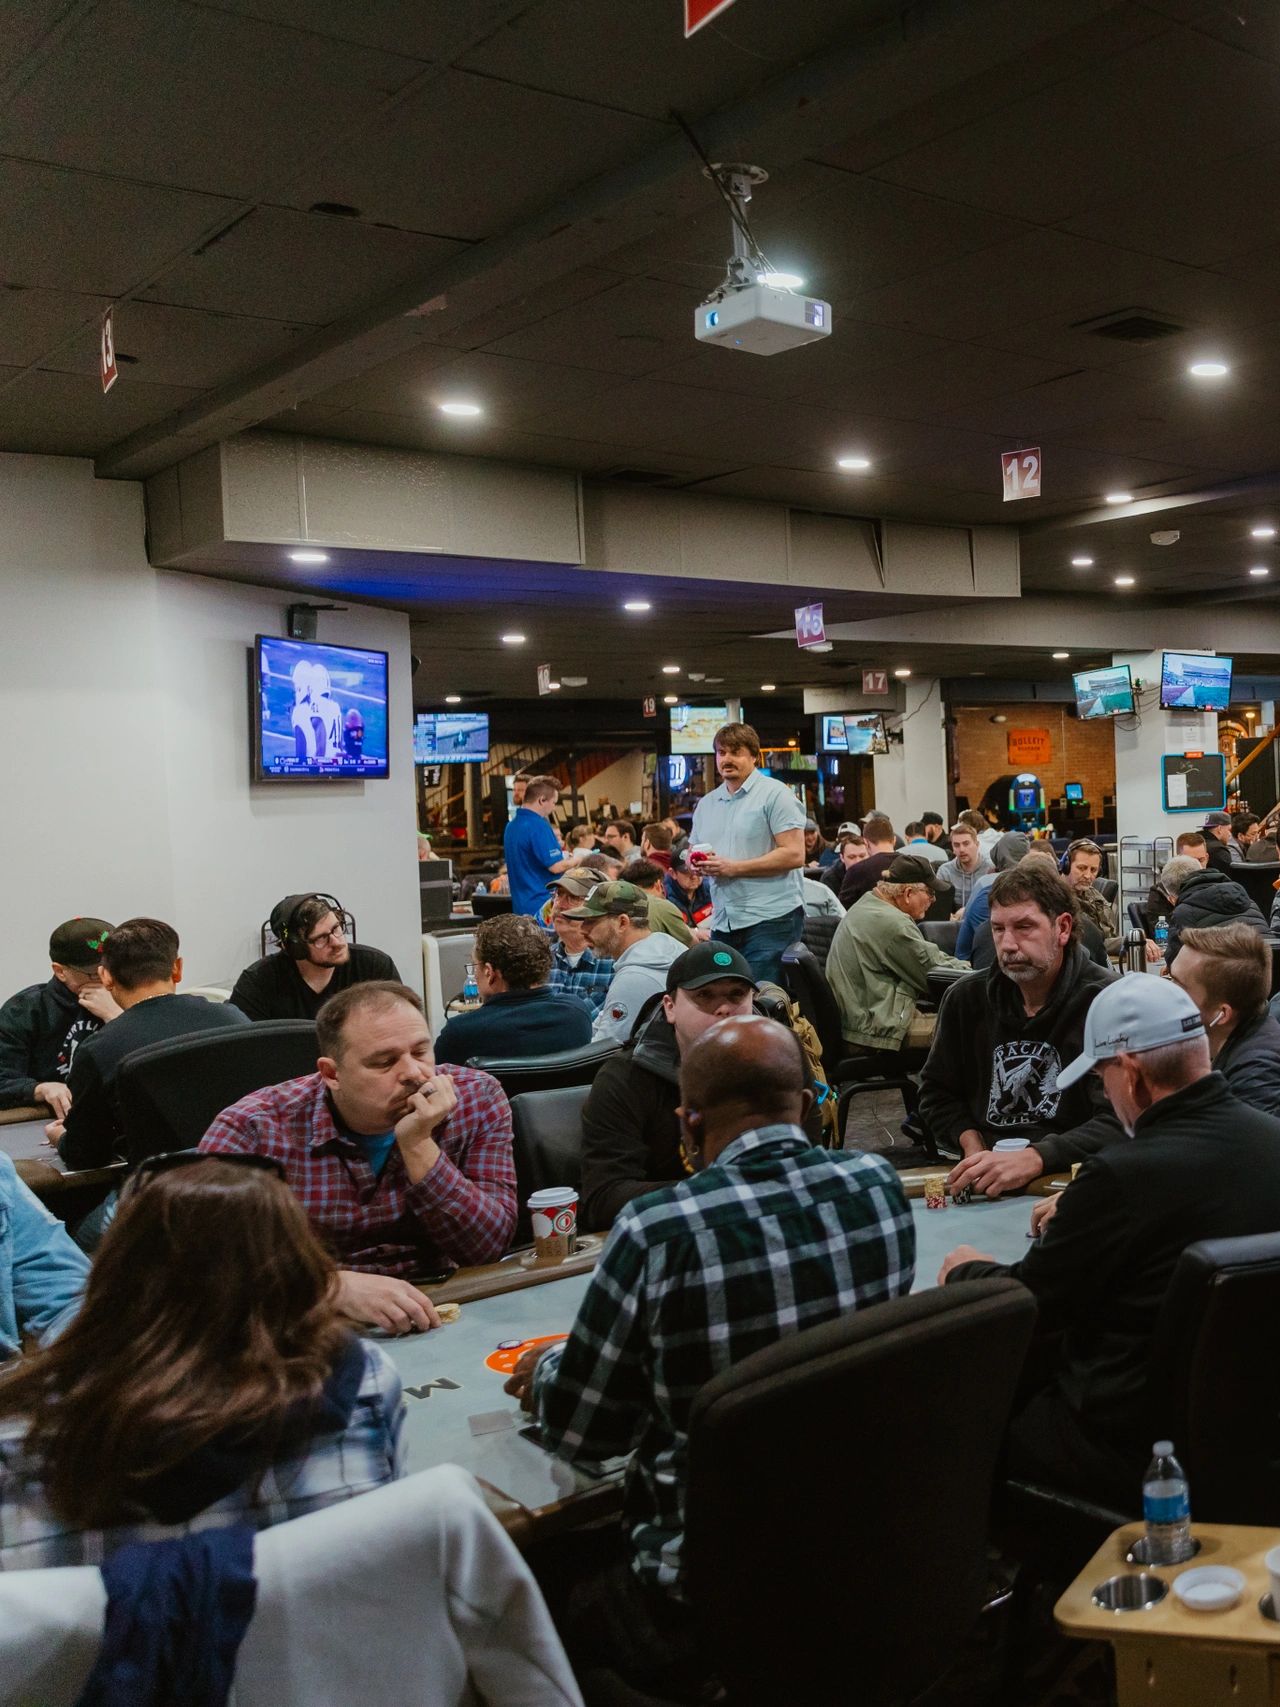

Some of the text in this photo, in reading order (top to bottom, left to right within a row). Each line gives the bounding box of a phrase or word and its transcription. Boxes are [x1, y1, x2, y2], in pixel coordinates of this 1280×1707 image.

[102, 318, 113, 374] 13
[1006, 455, 1038, 491] 12
[865, 672, 885, 689] 17
[643, 698, 655, 713] 19
